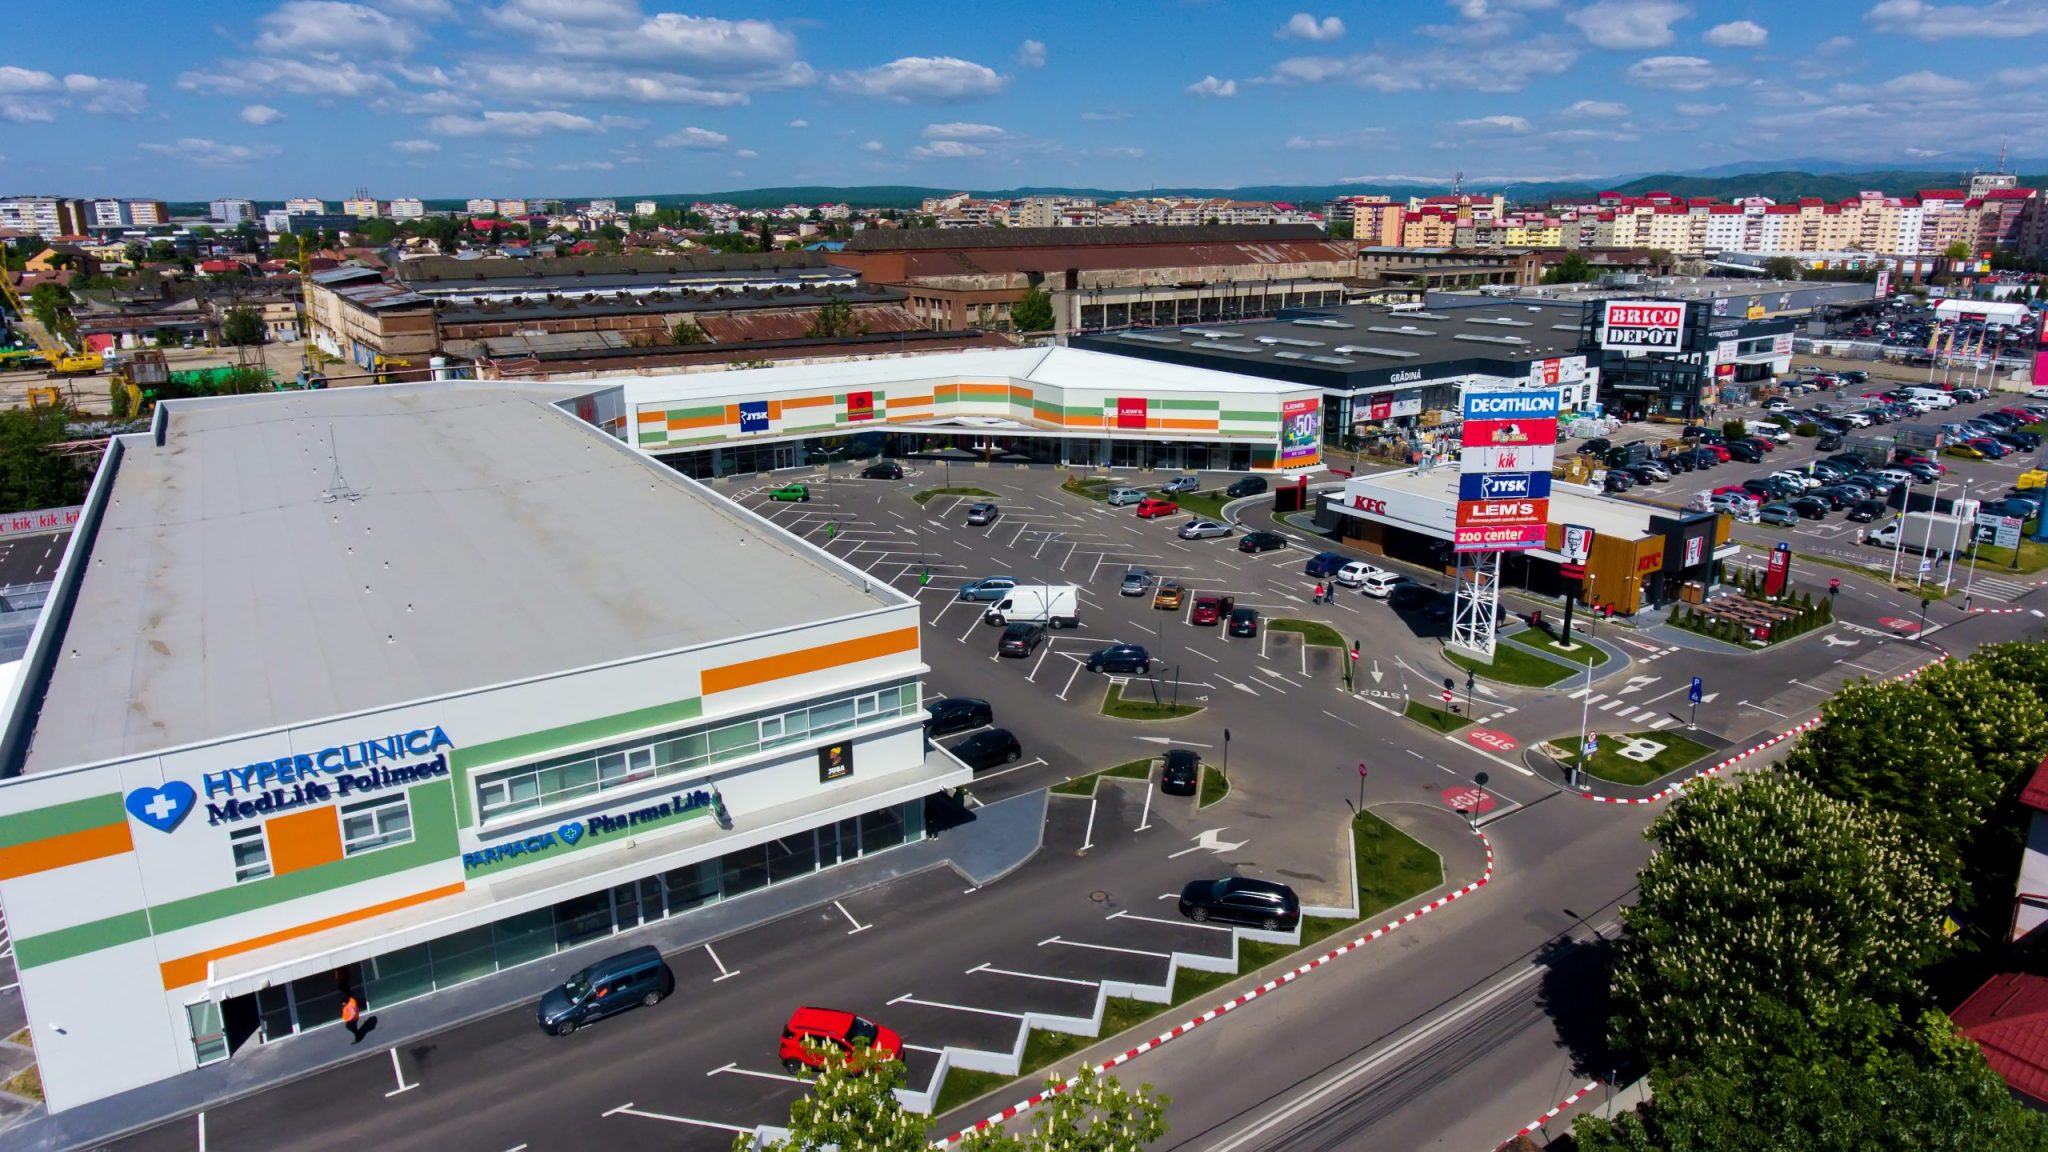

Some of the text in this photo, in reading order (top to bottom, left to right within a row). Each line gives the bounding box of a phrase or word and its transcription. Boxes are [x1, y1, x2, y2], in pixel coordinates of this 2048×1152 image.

[1611, 309, 1678, 324] BRICO
[1470, 397, 1555, 413] DECATHLON
[746, 411, 768, 421] JYSK
[1498, 453, 1516, 468] kik
[1491, 479, 1526, 492] JYSK
[1354, 495, 1387, 516] KFC
[1472, 502, 1534, 516] LEM'S
[12, 517, 31, 531] kik
[38, 514, 58, 528] kik
[1459, 529, 1524, 542] zoo center
[1638, 552, 1661, 571] KFC
[1360, 689, 1401, 699] STOP
[1471, 732, 1515, 750] STOP
[203, 725, 454, 798] HYPERCLINICA
[205, 753, 449, 824] MedLife Polimed
[1450, 789, 1490, 810] STOP
[463, 832, 558, 869] FARMACIA
